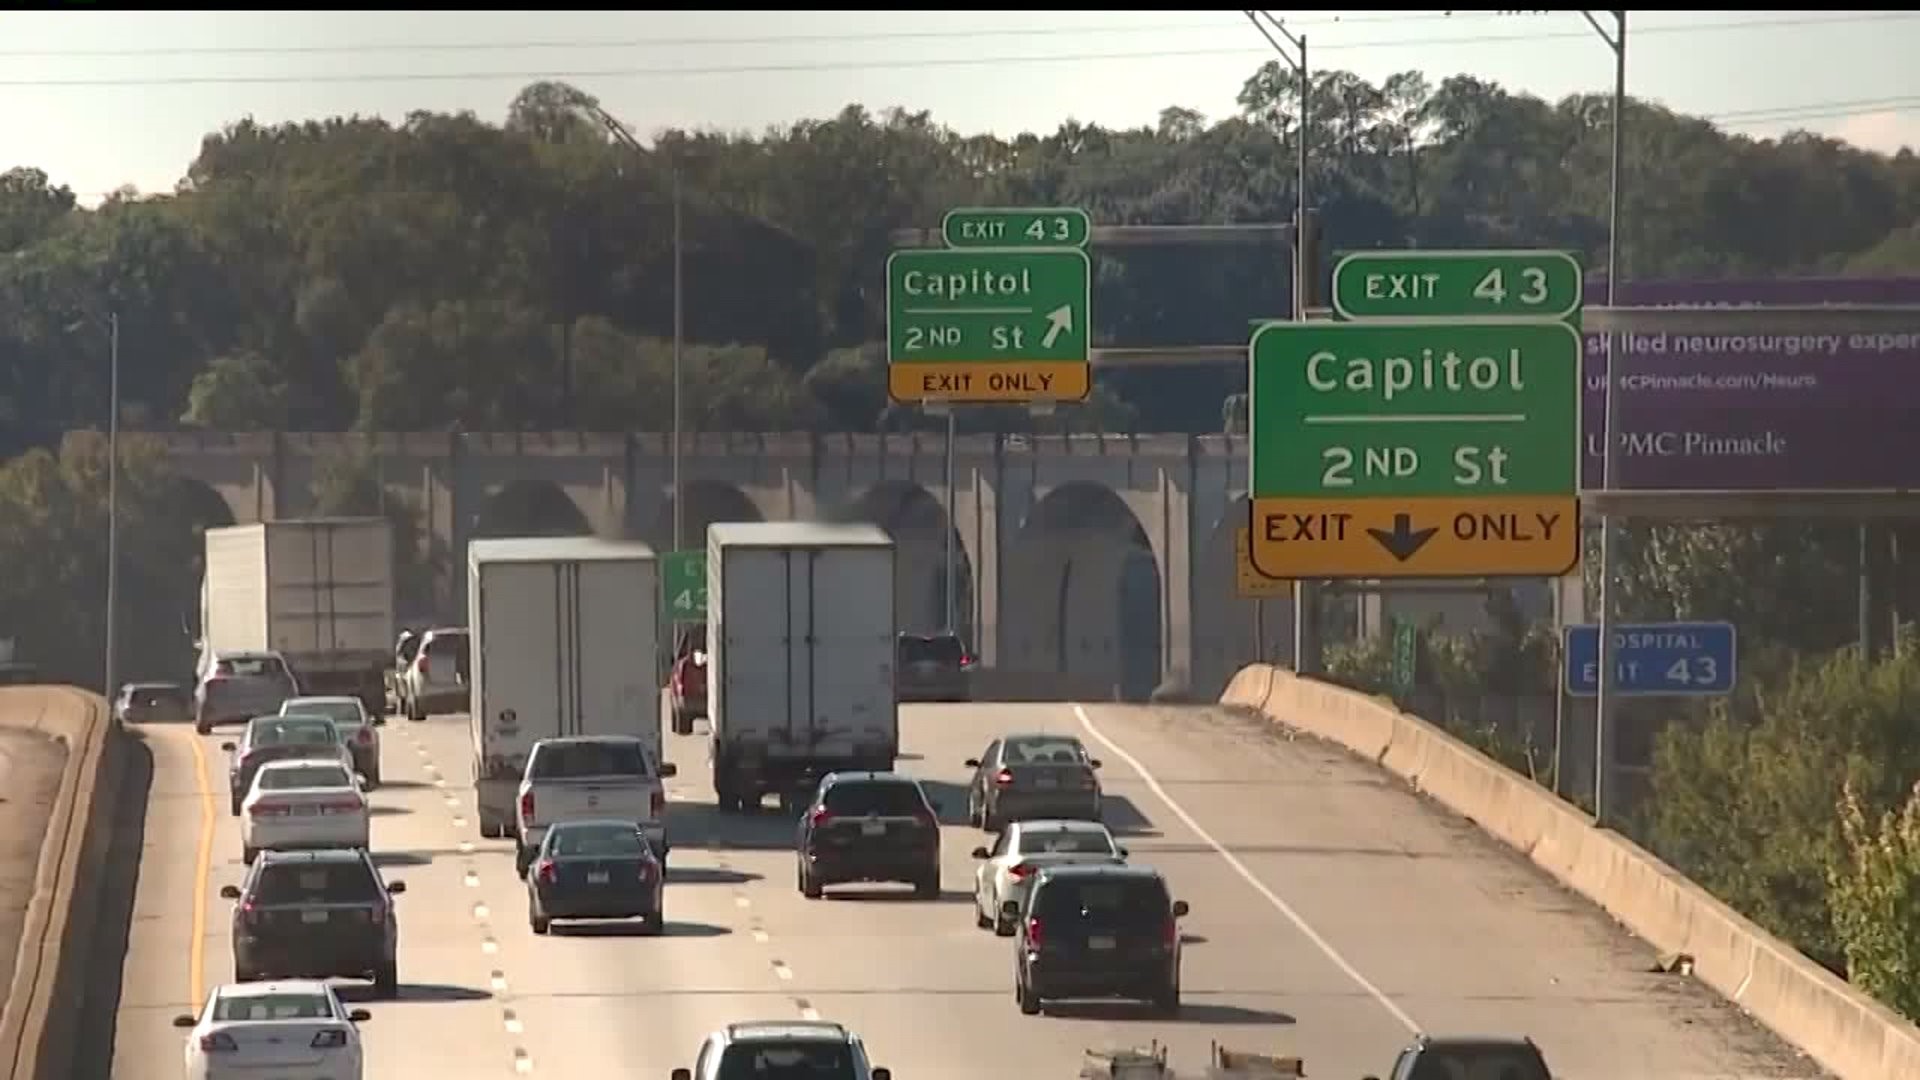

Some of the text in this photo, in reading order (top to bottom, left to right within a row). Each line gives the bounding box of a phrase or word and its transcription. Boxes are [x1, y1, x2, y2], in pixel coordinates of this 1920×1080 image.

[962, 217, 1069, 240] EXIT 43
[904, 268, 1031, 300] Capitol
[1366, 267, 1549, 304] EXIT 43
[905, 326, 1023, 350] 2ND St
[1587, 331, 1667, 354] sklled
[1675, 333, 1841, 356] neurosurgery
[923, 373, 1053, 391] EXIT ONLY
[1306, 349, 1525, 400] Capitol
[1587, 372, 1817, 391] UCPinnacle.com/Neuro
[1684, 431, 1786, 456] Pinnacle
[1322, 446, 1508, 486] 2ND St
[1265, 513, 1561, 541] EXIT ONLY
[1611, 633, 1702, 649] OSPITAL
[1582, 657, 1717, 685] EIT 43
